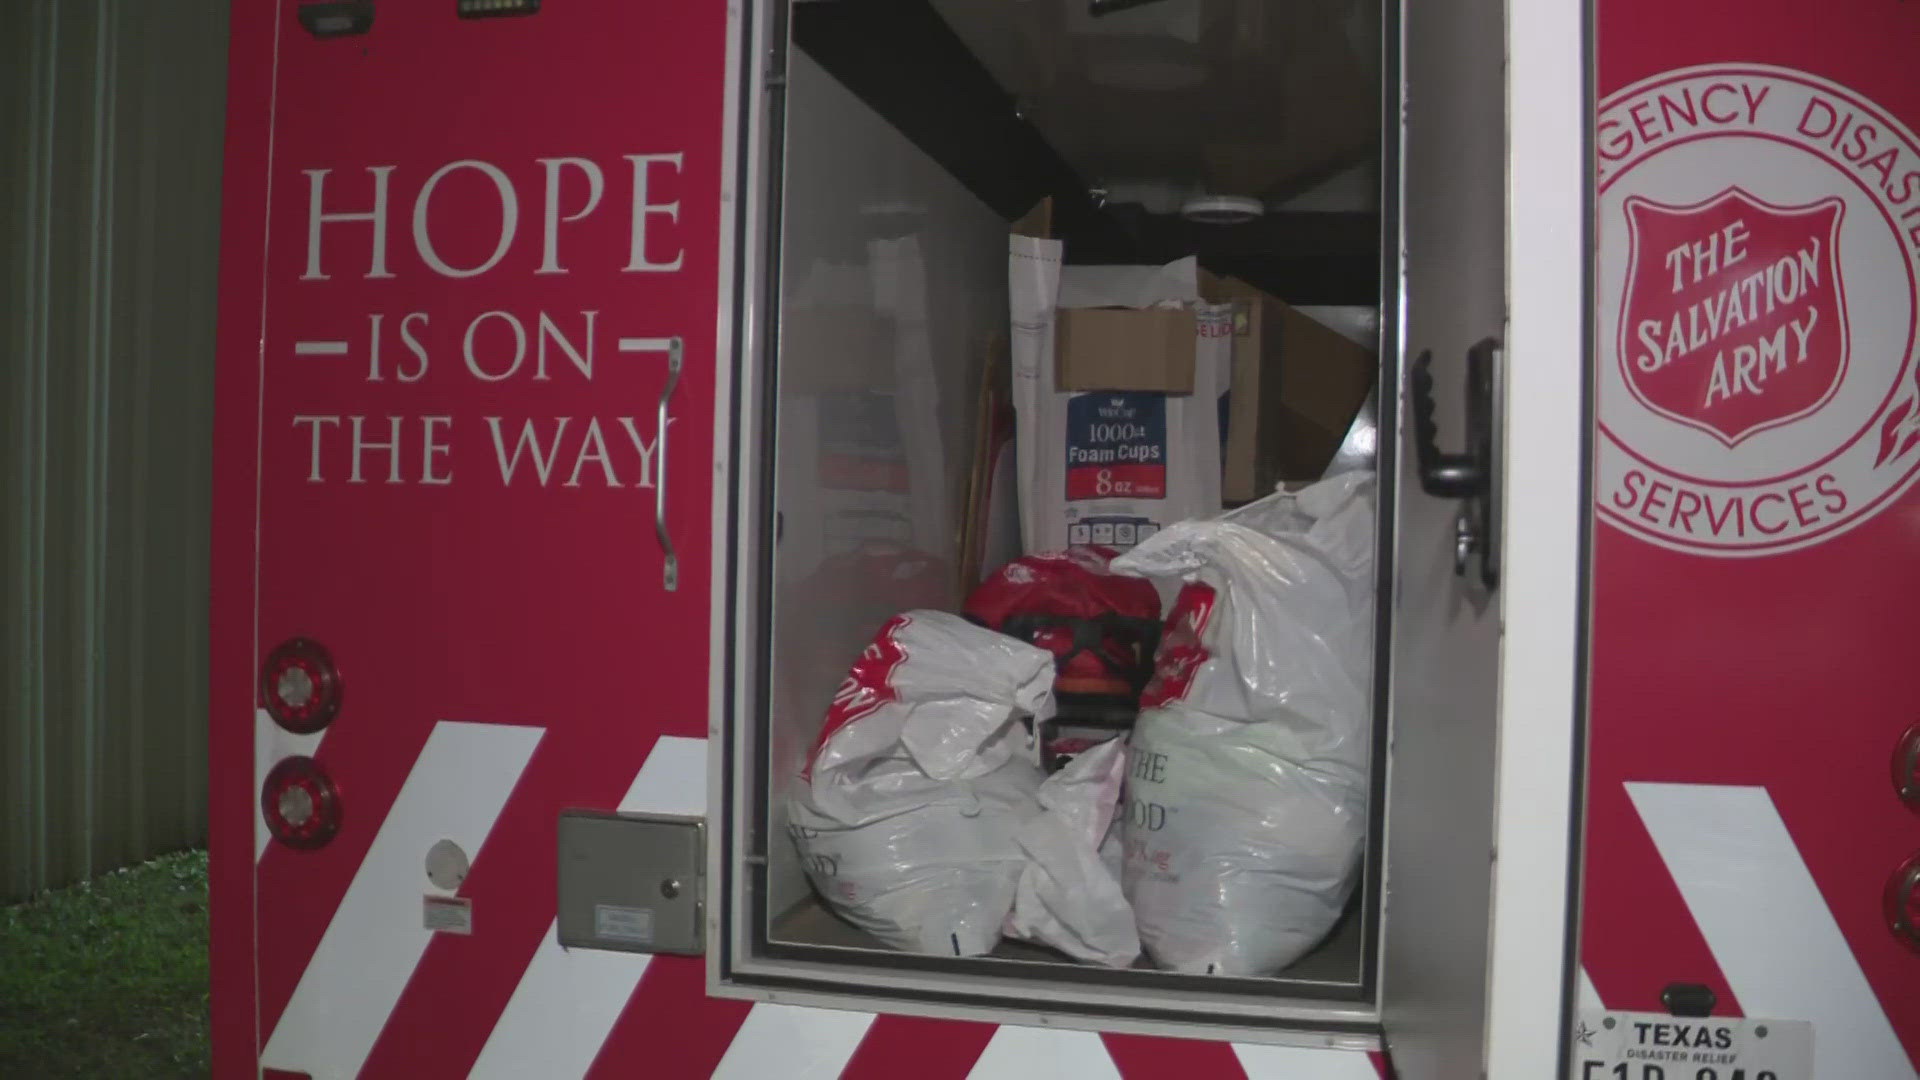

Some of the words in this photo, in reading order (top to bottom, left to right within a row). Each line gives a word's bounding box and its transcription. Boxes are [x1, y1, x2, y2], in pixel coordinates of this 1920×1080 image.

[1598, 82, 1770, 175] GENCY
[299, 152, 685, 280] HOPE
[1665, 219, 1751, 294] THE
[1637, 236, 1821, 372] SALVATION
[365, 312, 429, 382] IS
[462, 310, 599, 381] ON
[1703, 304, 1818, 409] ARMY
[292, 415, 454, 485] THE
[484, 415, 678, 488] WAY
[1068, 446, 1115, 463] Foam
[1117, 444, 1160, 462] Cups
[1096, 468, 1112, 495] 8
[1114, 481, 1132, 493] oz
[1612, 469, 1847, 537] SERVICES
[1626, 1049, 1689, 1063] DISASTER
[1692, 1052, 1739, 1065] RELIEF
[1633, 1022, 1733, 1049] TEXAS
